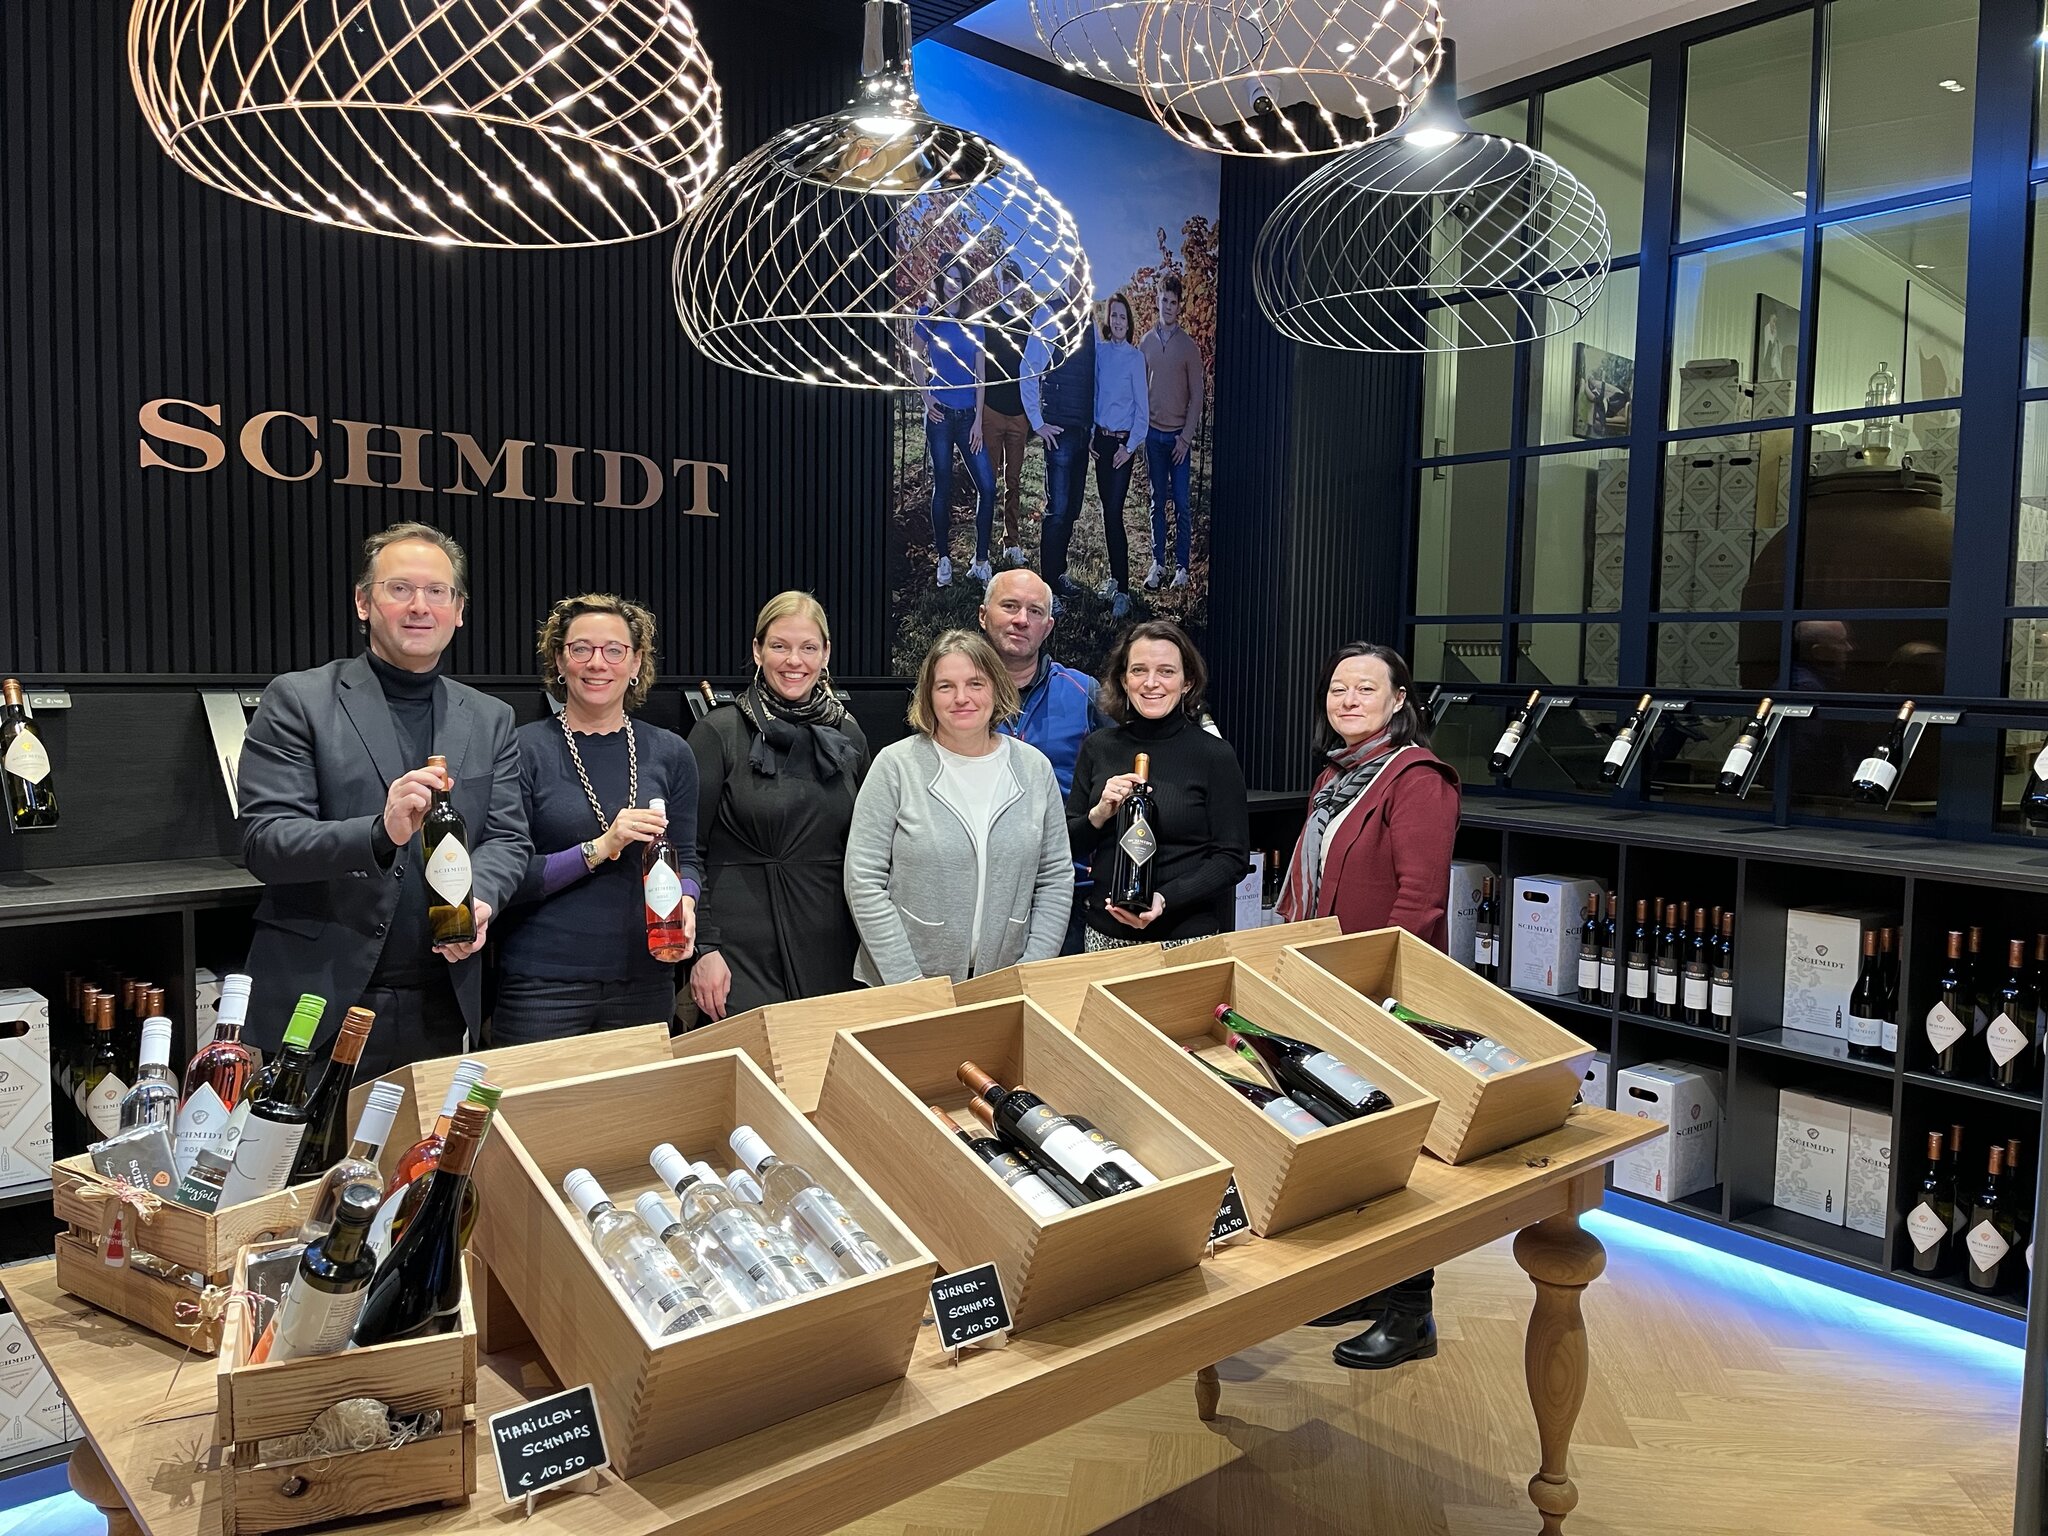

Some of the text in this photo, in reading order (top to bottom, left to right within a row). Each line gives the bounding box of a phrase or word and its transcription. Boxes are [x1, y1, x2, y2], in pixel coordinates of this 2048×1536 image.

[138, 398, 729, 517] SCHMIDT
[1517, 922, 1554, 934] SCHMIDT
[1796, 956, 1846, 969] SCHMIDT
[1676, 1120, 1713, 1137] SCHMIDT
[1789, 1136, 1836, 1154] SCHMIDT
[1218, 1218, 1243, 1235] 13,90
[948, 1296, 996, 1319] SCHNAPS
[951, 1315, 999, 1341] € 10,50
[521, 1424, 591, 1457] SCHNAPS
[518, 1455, 586, 1487] € 10,50
